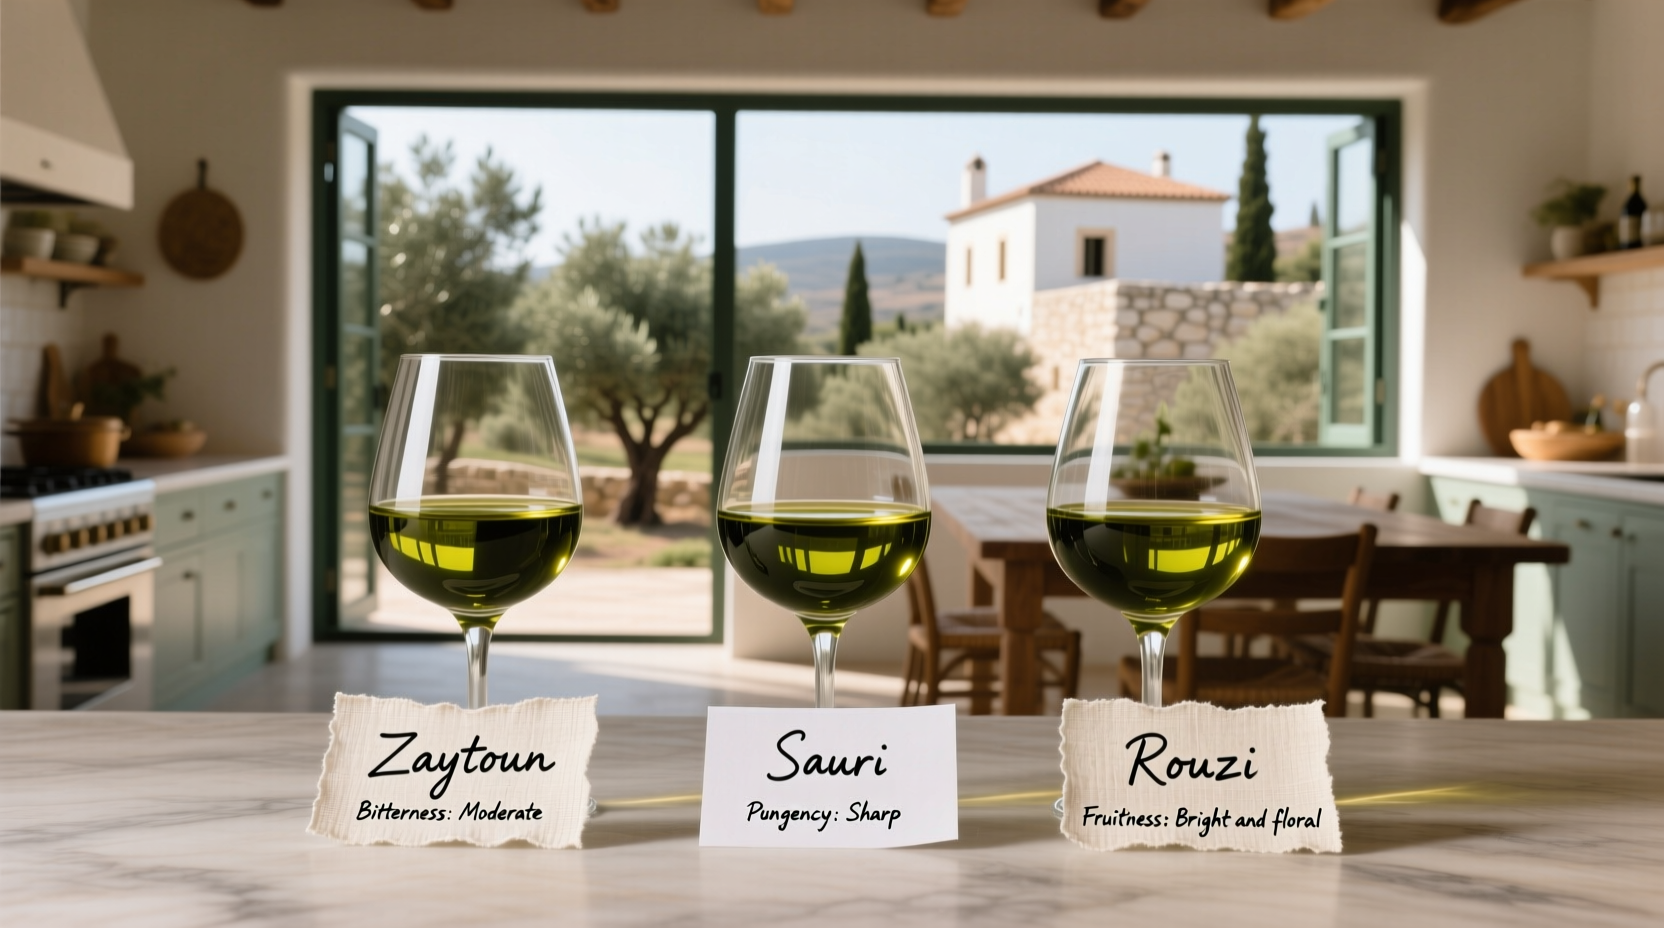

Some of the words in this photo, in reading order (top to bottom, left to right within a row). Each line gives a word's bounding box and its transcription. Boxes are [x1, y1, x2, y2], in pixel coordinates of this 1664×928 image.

[367, 731, 556, 800] Zaytoun
[766, 729, 888, 782] Sauri
[1125, 732, 1259, 787] Rouzi
[356, 799, 453, 821] Bitterness:
[458, 801, 543, 821] Moderate
[747, 800, 839, 832] Pungency:
[845, 800, 902, 830] Sharp
[1175, 806, 1232, 838] Bright
[1234, 808, 1268, 829] and
[1271, 806, 1323, 837] floral
